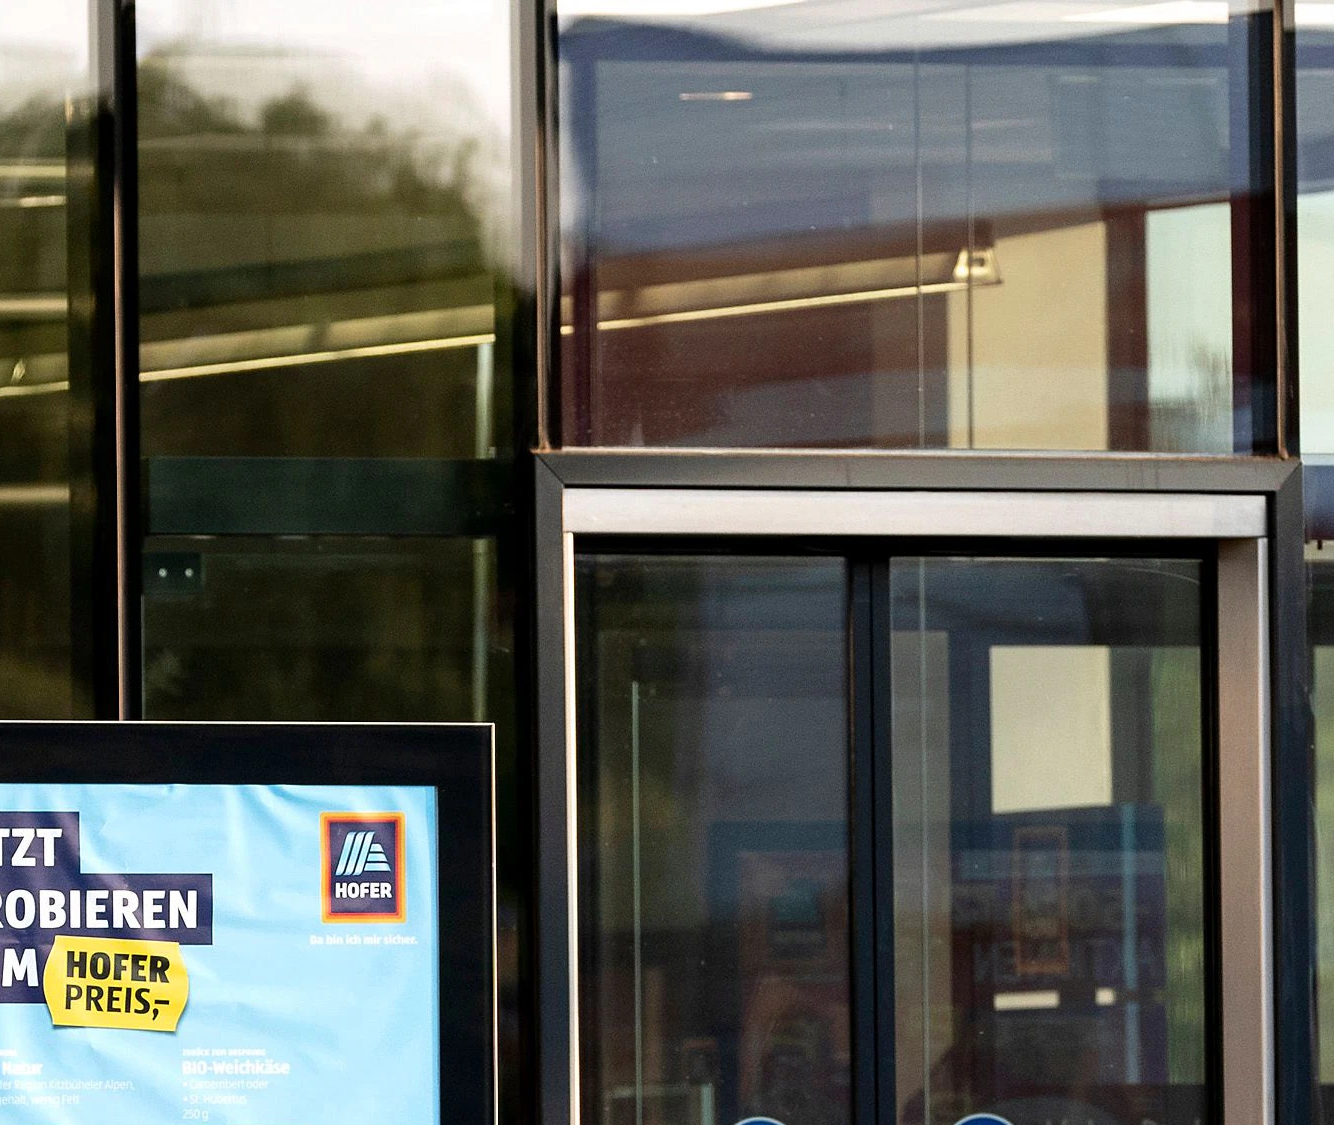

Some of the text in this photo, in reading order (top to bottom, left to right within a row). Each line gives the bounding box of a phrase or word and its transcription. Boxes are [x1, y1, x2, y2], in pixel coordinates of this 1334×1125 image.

[335, 882, 393, 899] HOFER
[66, 951, 170, 984] HOFER
[65, 984, 170, 1021] PREIS,-
[182, 1059, 291, 1075] BIO-Weichkäse
